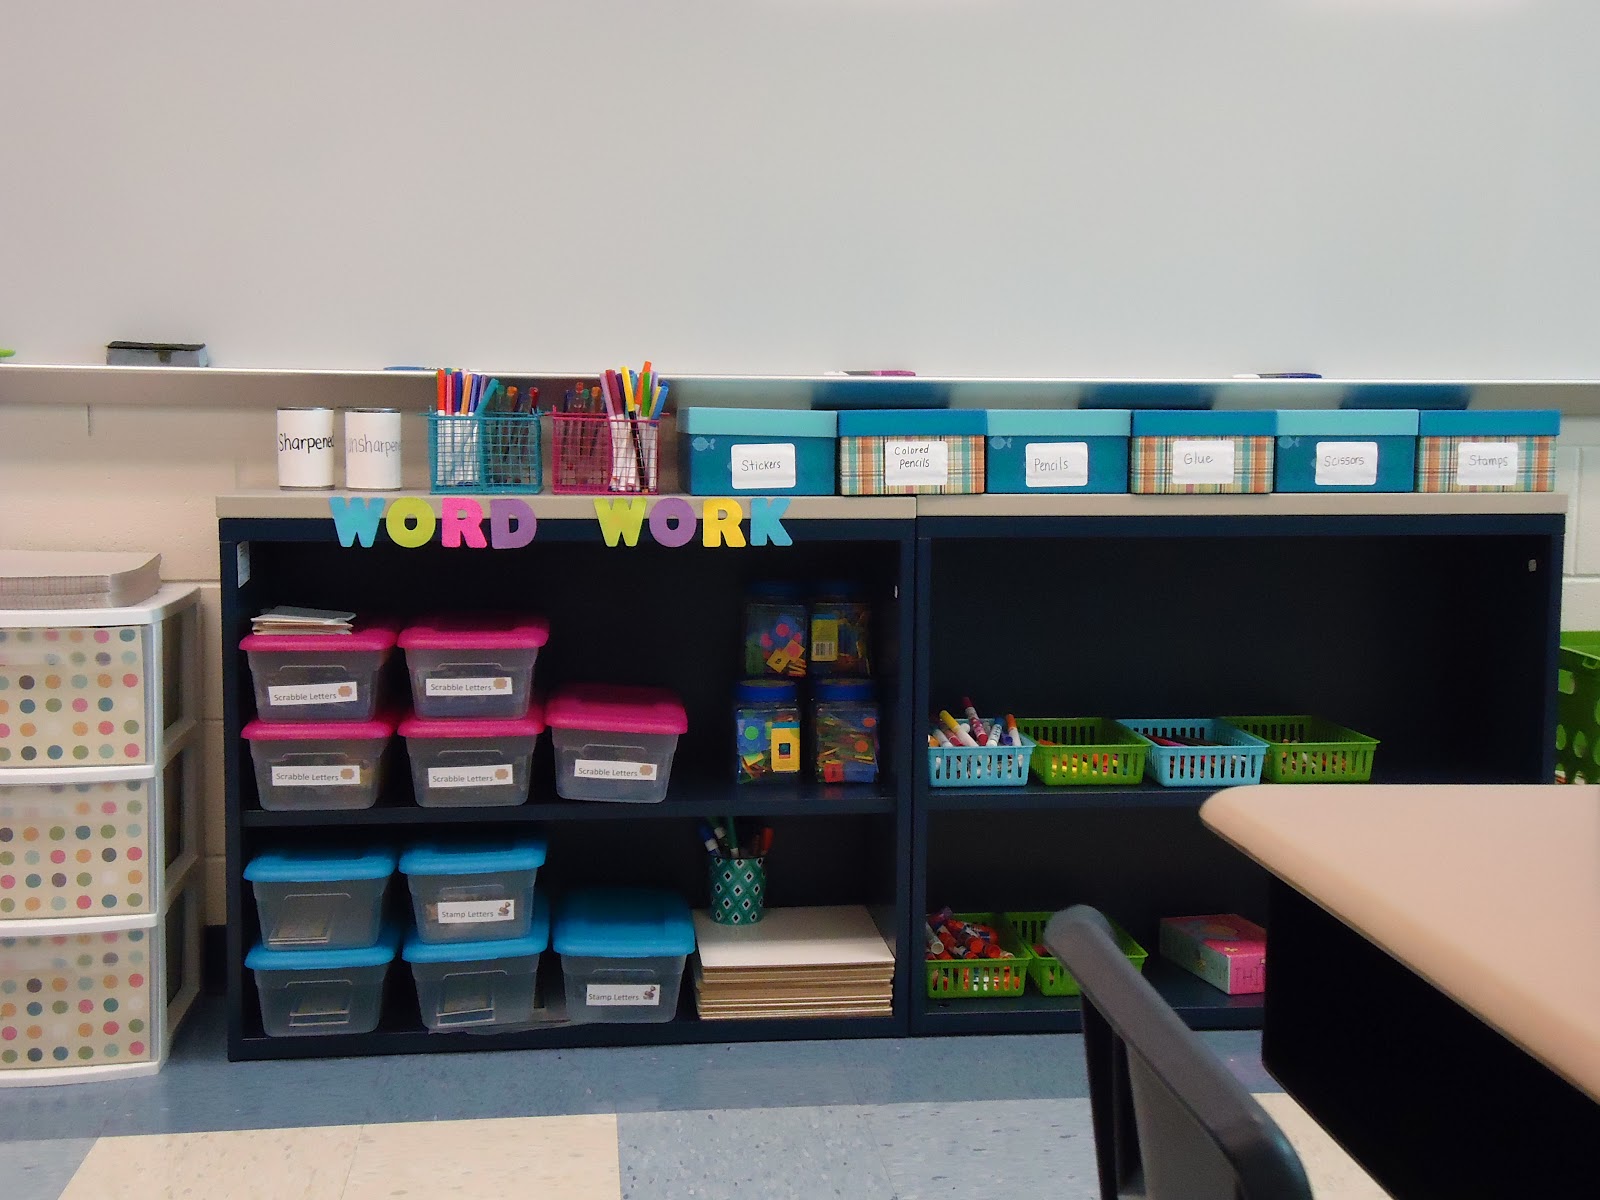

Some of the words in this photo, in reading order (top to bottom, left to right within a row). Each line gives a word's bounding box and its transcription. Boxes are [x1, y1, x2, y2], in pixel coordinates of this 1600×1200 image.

[894, 444, 930, 456] Colored
[1034, 456, 1069, 472] Pencils
[1183, 451, 1214, 465] Glue
[1324, 455, 1365, 468] Scissors
[1468, 454, 1508, 469] Stamps
[741, 459, 781, 472] Stickers
[328, 496, 537, 550] WORD
[593, 497, 793, 548] WORK
[430, 683, 464, 691] Scrabble
[275, 773, 310, 781] Scrabble
[578, 767, 610, 776] Scrabble
[612, 769, 638, 777] Letters
[432, 775, 465, 783] Scrabble
[466, 775, 494, 783] Letters
[467, 910, 494, 918] Letters
[588, 993, 612, 1001] Stamp
